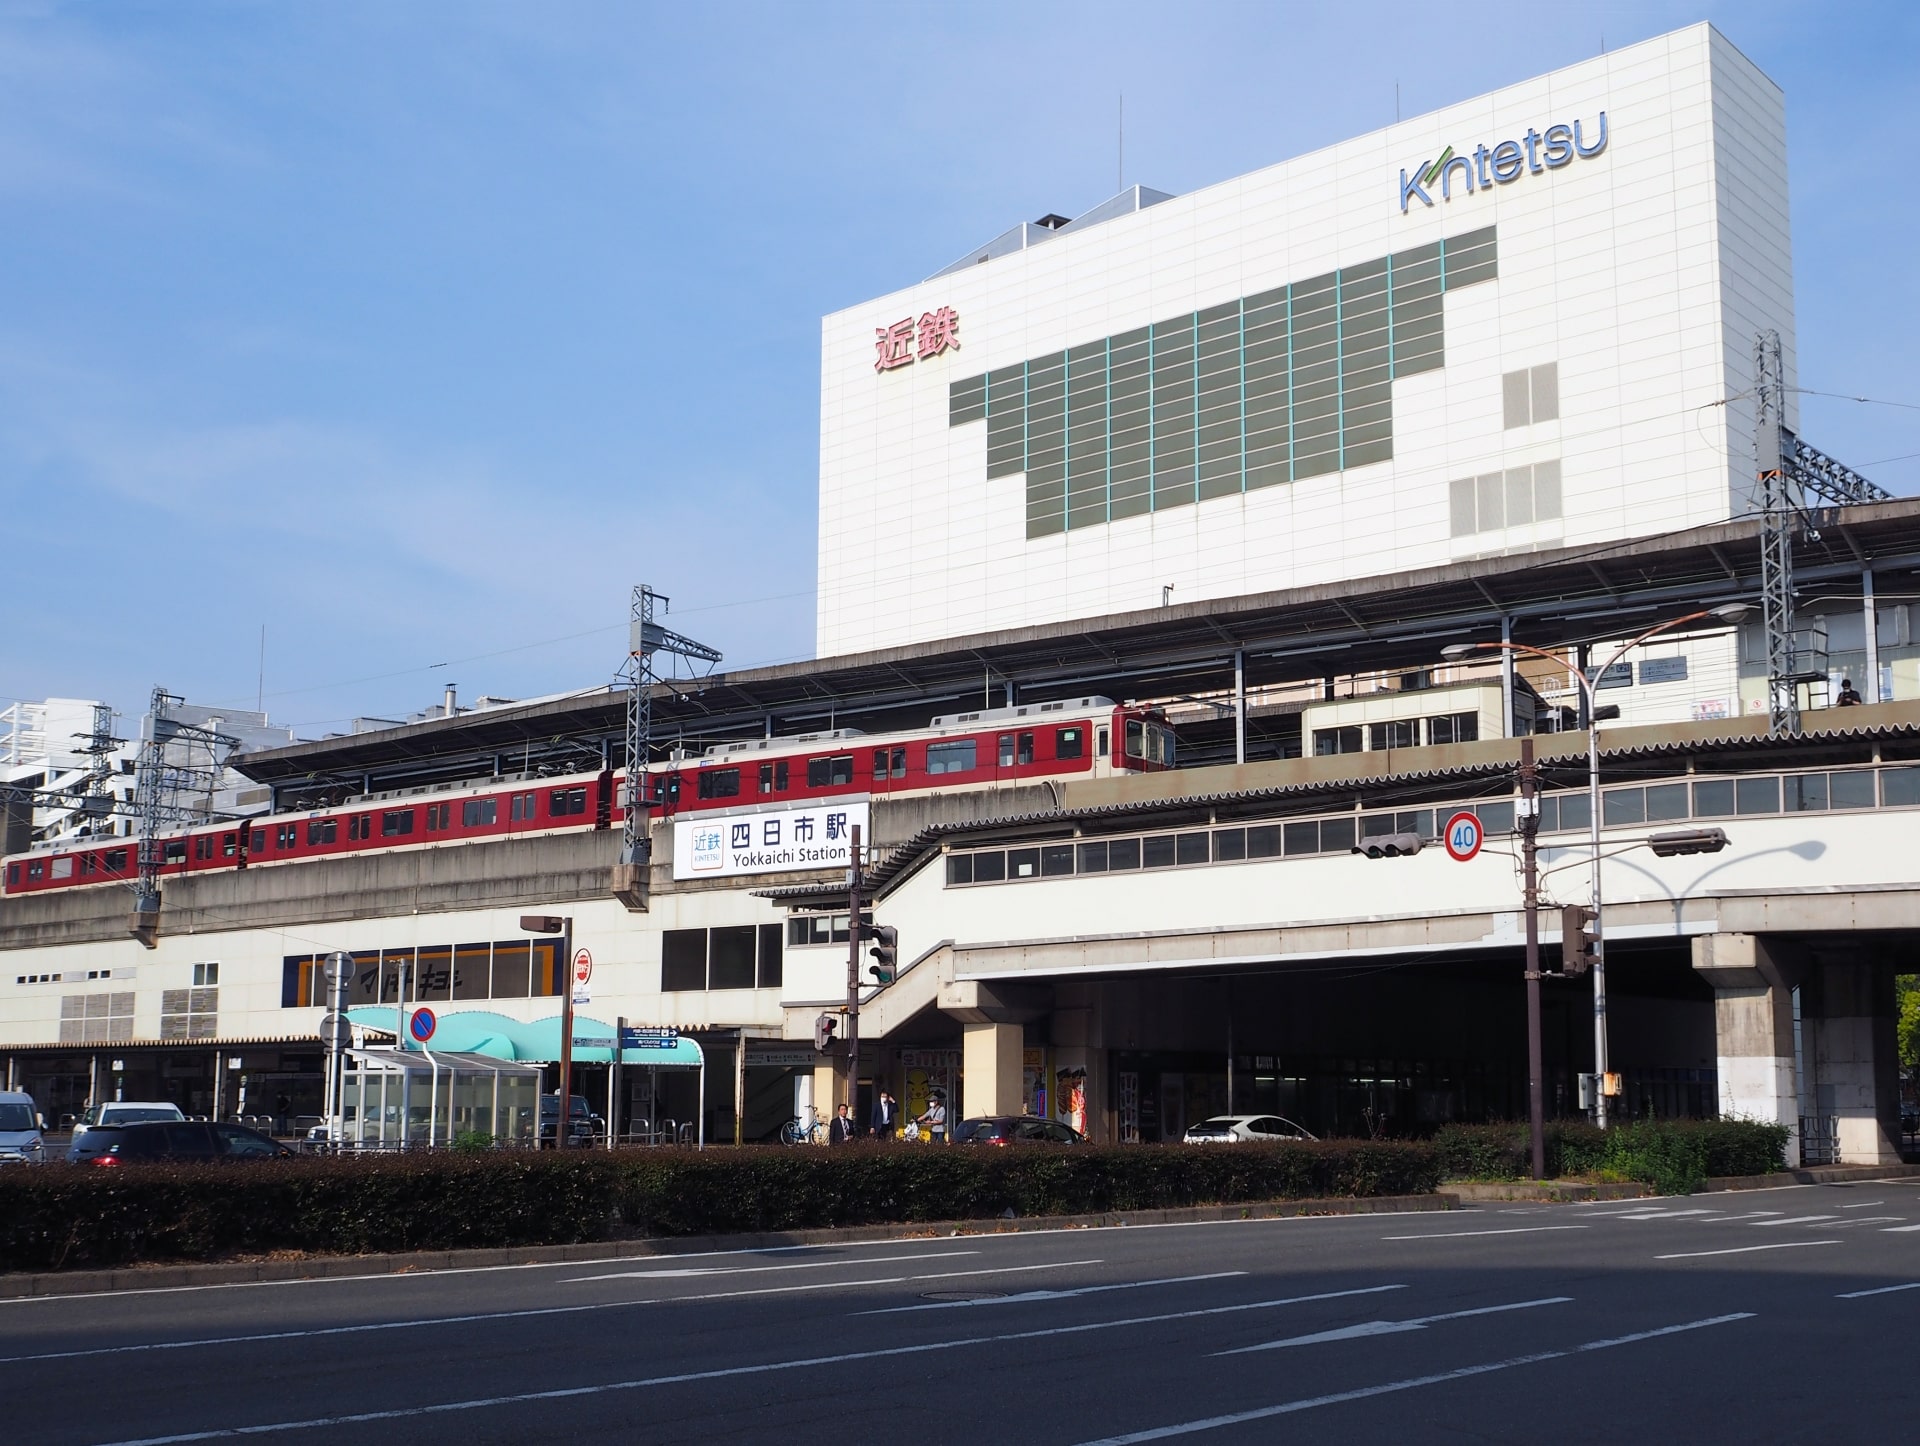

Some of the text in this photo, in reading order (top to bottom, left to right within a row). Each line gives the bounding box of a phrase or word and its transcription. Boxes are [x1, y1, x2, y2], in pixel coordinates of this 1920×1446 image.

[1400, 111, 1609, 212] Kintetsu
[874, 306, 960, 374] 近鉄
[694, 831, 721, 851] 近鉄
[731, 812, 847, 849] 四日市駅
[1453, 825, 1474, 848] 40
[694, 853, 720, 862] KINTETSU
[733, 846, 846, 867] Yokkaichi Station
